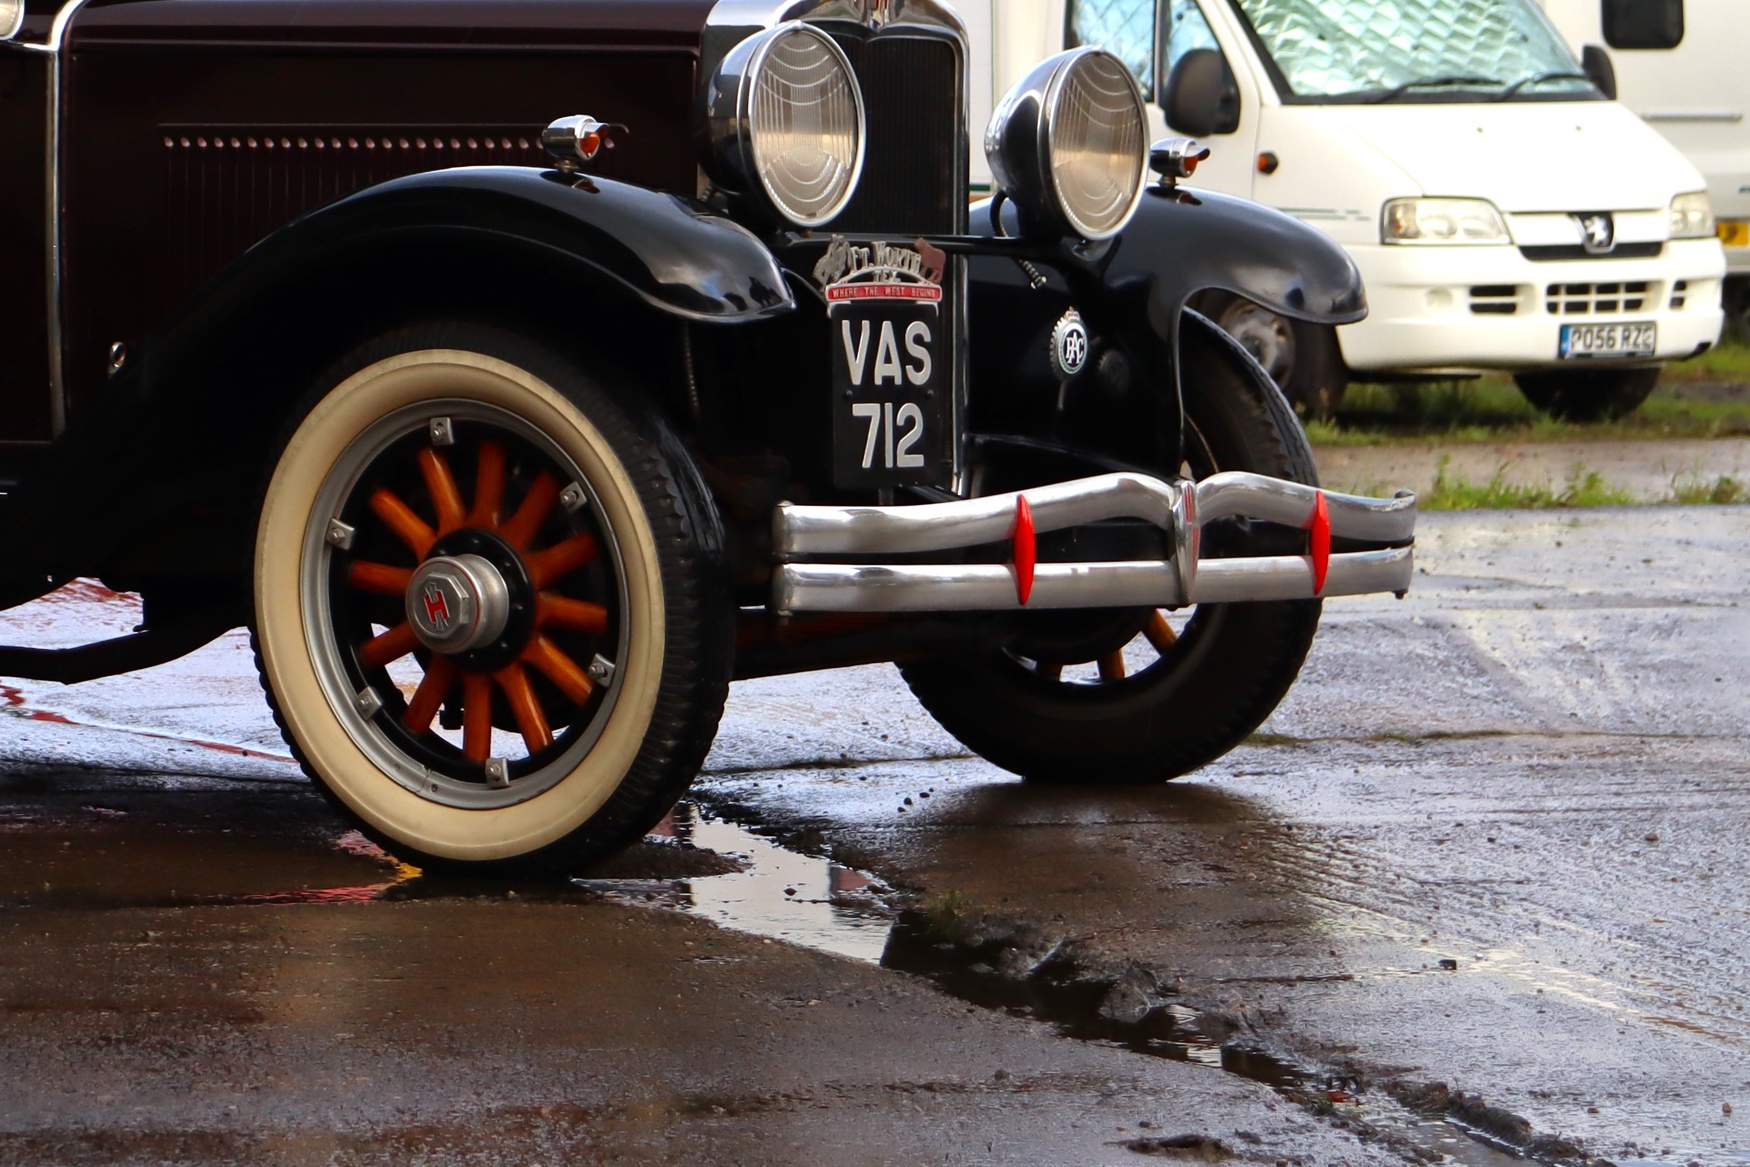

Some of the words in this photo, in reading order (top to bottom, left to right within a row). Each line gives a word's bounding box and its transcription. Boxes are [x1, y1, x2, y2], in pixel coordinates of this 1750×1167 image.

[832, 288, 858, 298] WHERE
[864, 287, 878, 296] THE
[884, 287, 905, 296] WEST
[911, 288, 936, 298] BEGINS
[841, 319, 932, 386] VAS
[1065, 331, 1084, 364] RAC
[852, 402, 925, 469] 712
